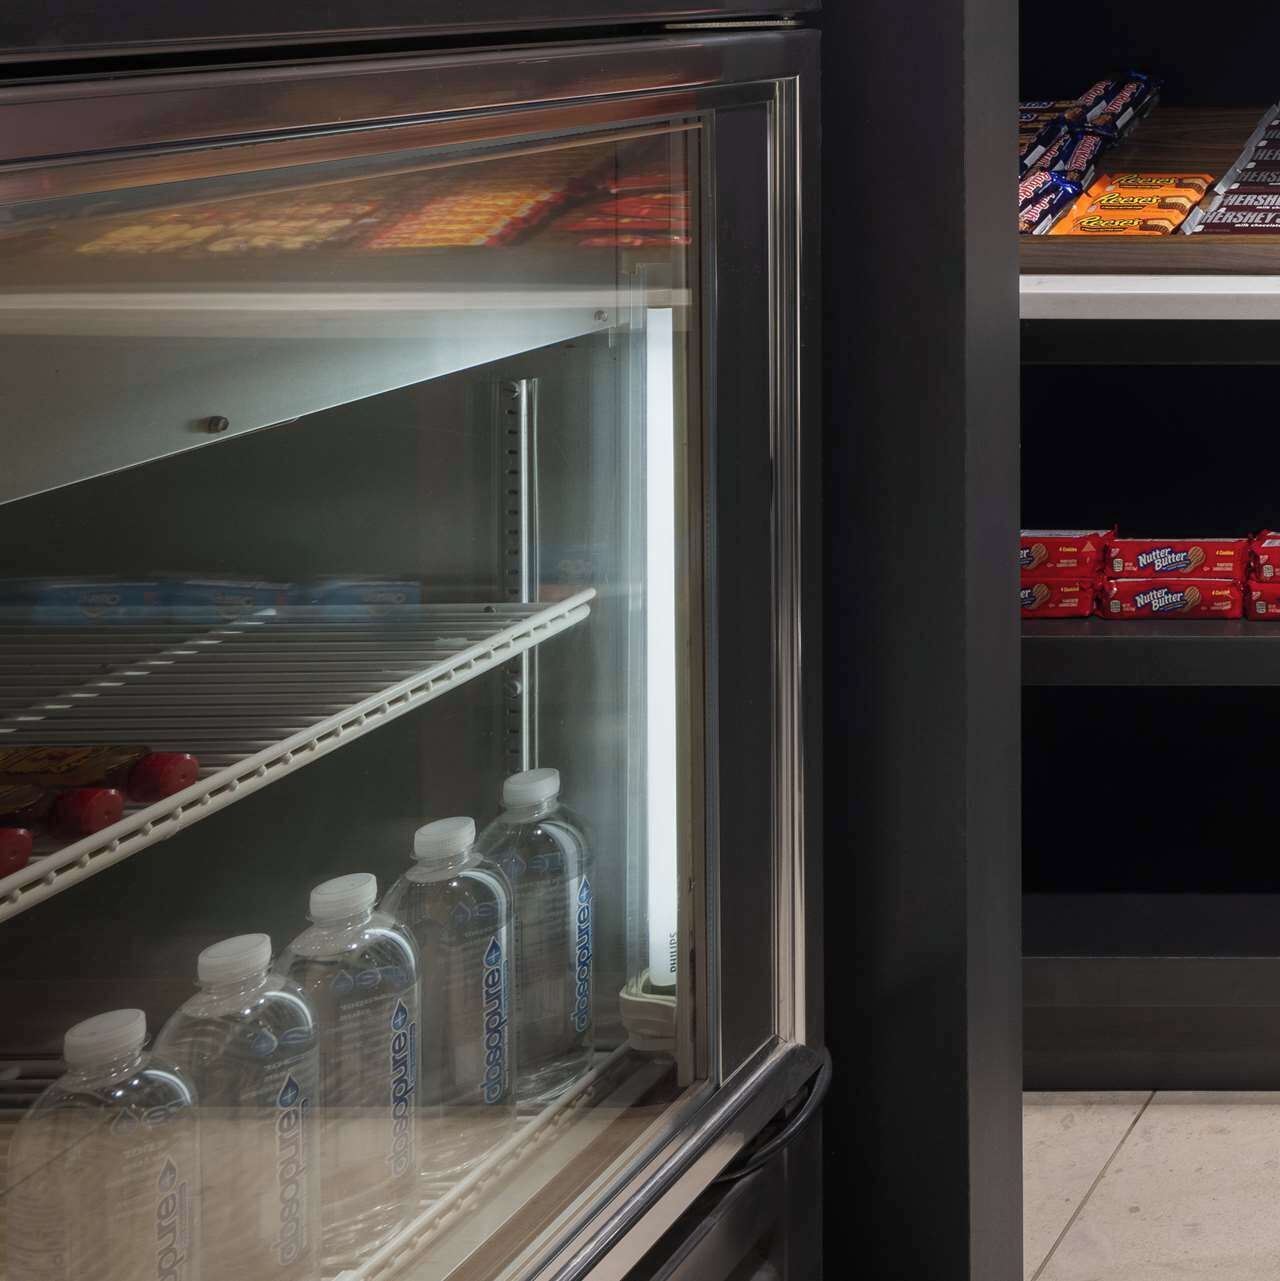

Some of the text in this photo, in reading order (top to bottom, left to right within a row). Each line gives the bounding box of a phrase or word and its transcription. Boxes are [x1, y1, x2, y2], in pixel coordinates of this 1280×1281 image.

[1138, 547, 1172, 567] Nutter
[1155, 552, 1187, 571] Butter
[1136, 588, 1168, 607] Nutter
[1152, 592, 1183, 611] Butter
[570, 904, 592, 1033] absopure
[482, 967, 507, 1104] absopure
[388, 1031, 414, 1179] absopure
